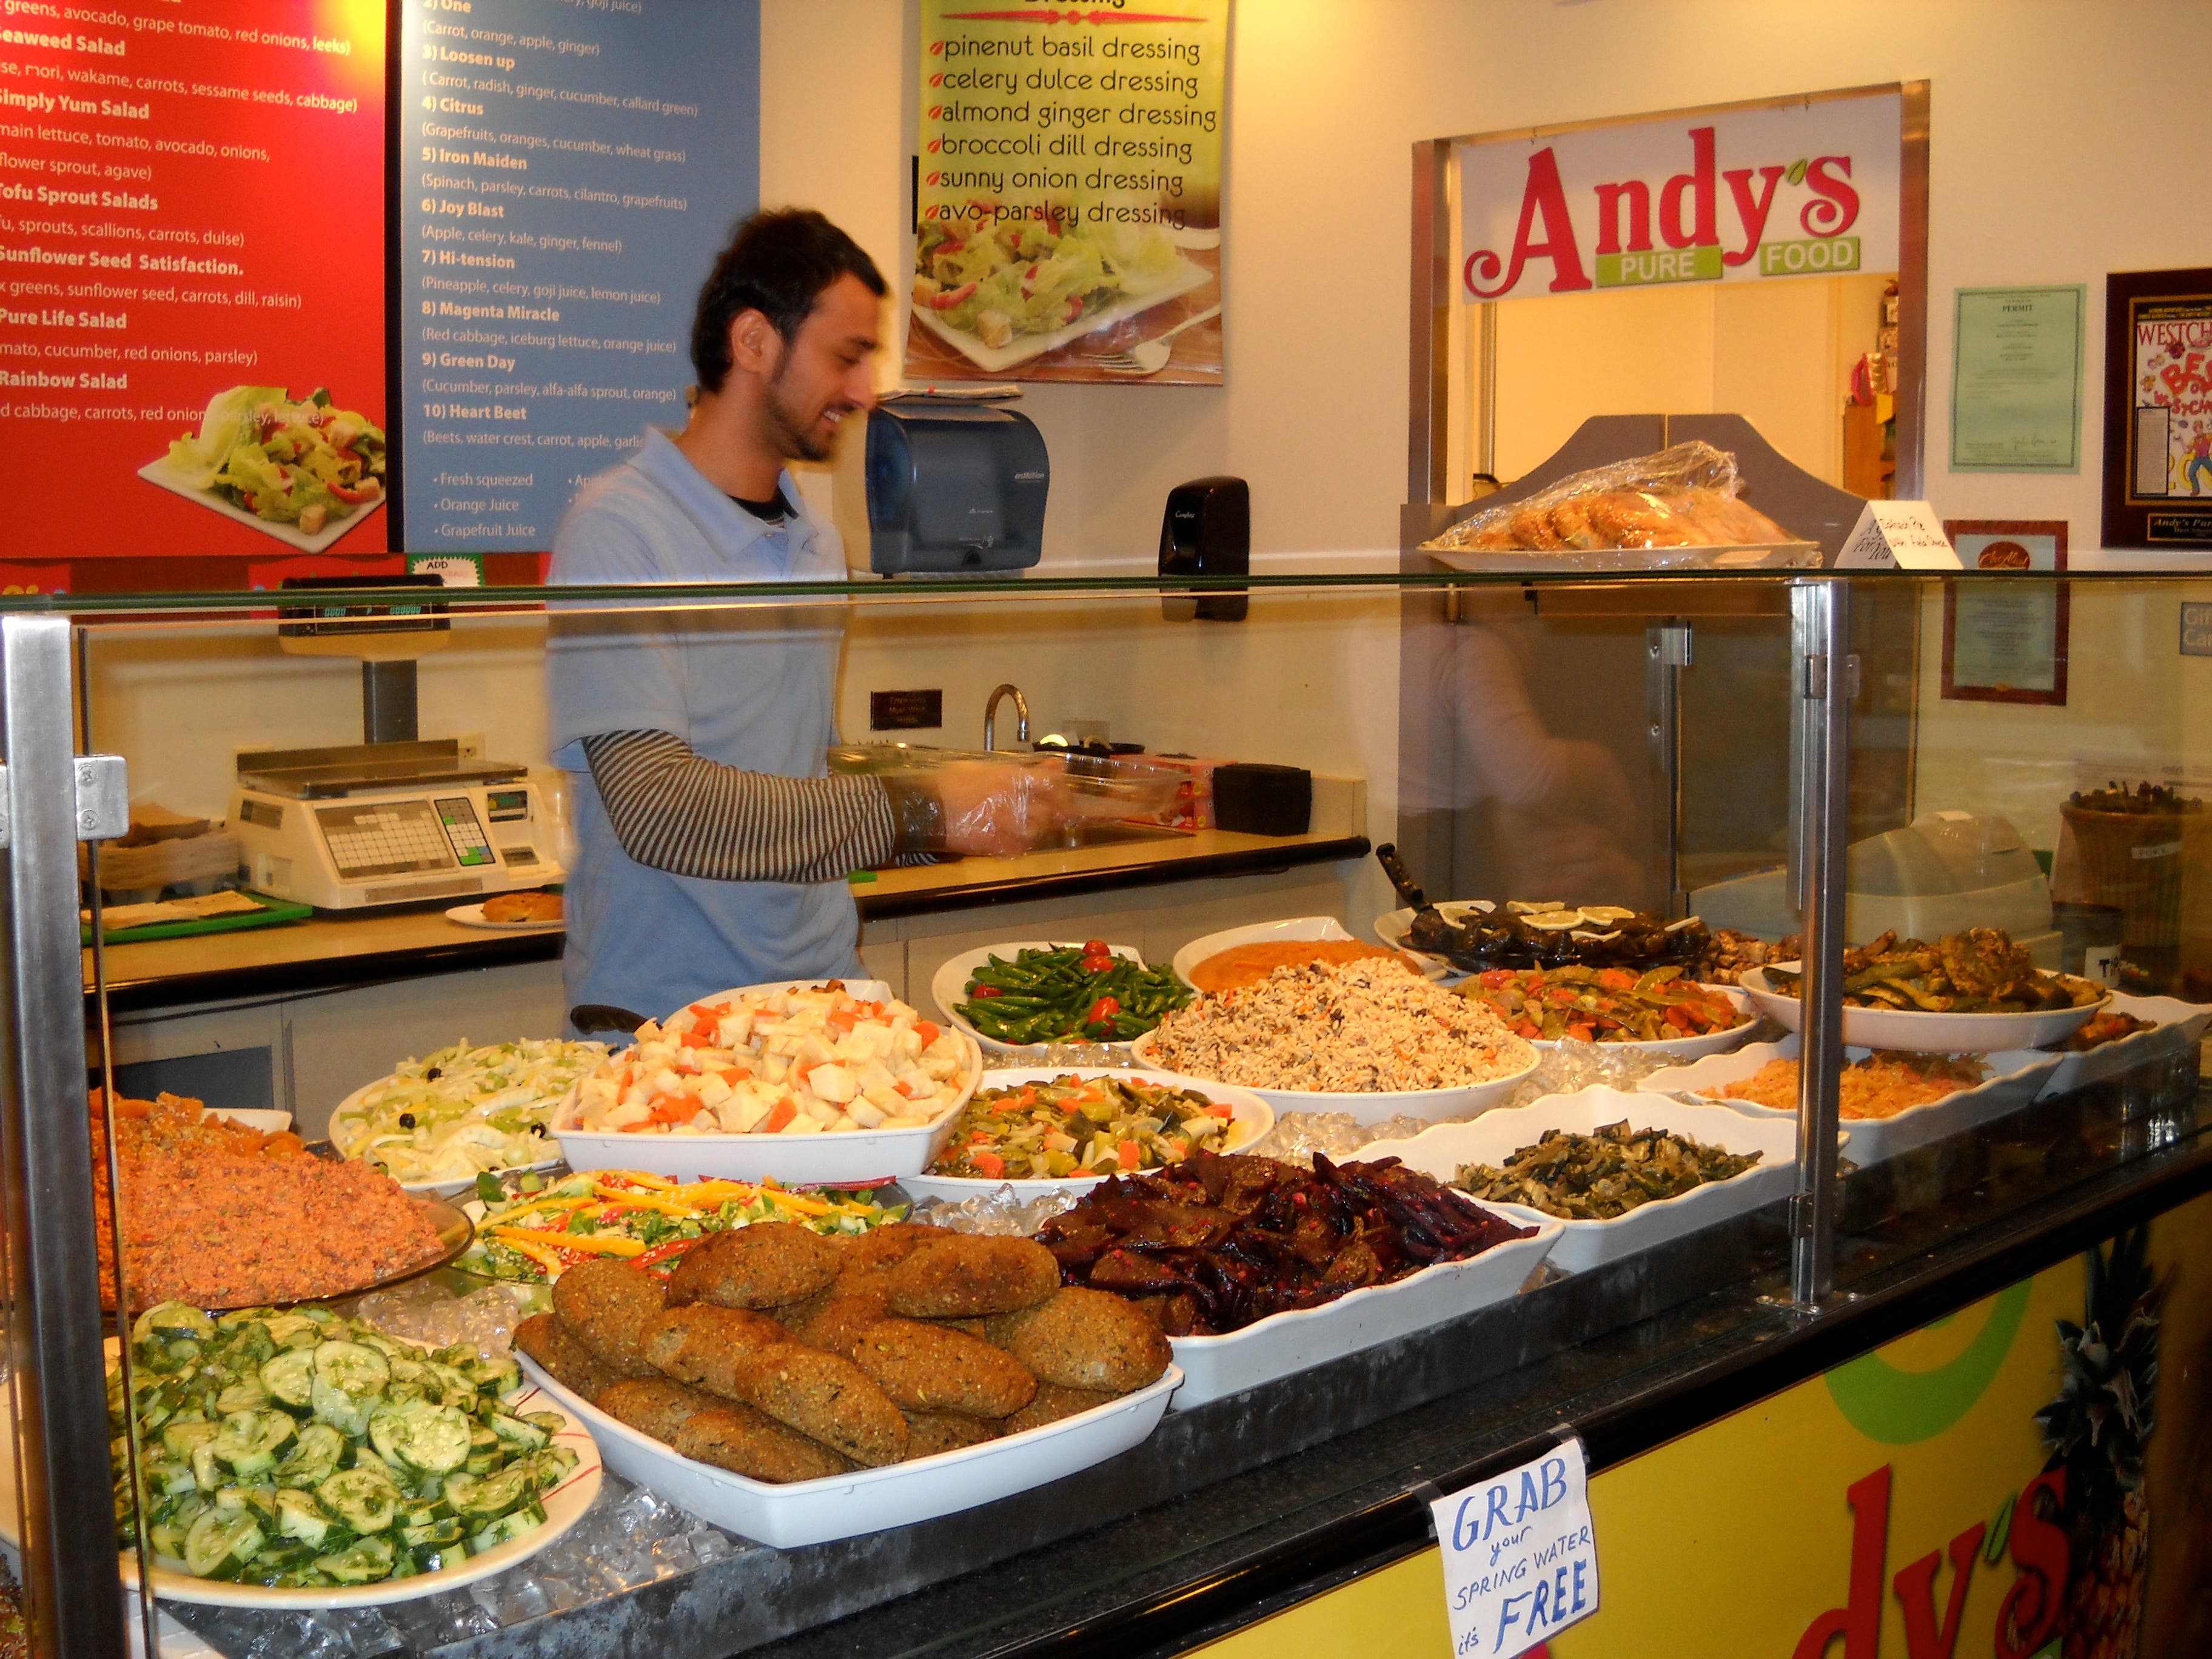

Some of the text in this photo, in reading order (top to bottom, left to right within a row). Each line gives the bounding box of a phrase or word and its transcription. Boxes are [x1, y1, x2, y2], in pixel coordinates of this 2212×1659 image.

[0, 25, 126, 56] eaweed Salad
[5, 0, 350, 56] greens, avocado, grape tomato, red onions, leeks)
[471, 29, 600, 56] orange, apple, ginger)
[945, 35, 1200, 65] pinenut basil dressing
[440, 47, 515, 72] Loosen up
[68, 69, 357, 113] wakame, carrots, sessame seeds, cabbage)
[943, 67, 1198, 99] celery dulce dressing
[59, 95, 149, 119] Yum Salad
[440, 96, 484, 115] Citrus
[474, 78, 698, 117] radish, ginger, cucumber, green)
[942, 100, 1216, 132] almond ginger dressing
[38, 124, 270, 163] lettuce, tomato, avocado, onions,
[500, 133, 686, 163] oranges, cucumber, wheat grass)
[942, 133, 1192, 164] broccoli dill dressing
[50, 160, 152, 181] sprout, agave)
[440, 148, 528, 170] Iron Maiden
[940, 167, 1183, 197] sunny onion dressing
[38, 186, 158, 210] Sprout Salads
[440, 199, 504, 218] Joy Blast
[481, 181, 687, 211] parsley, carrots, cilantro, grapefruits)
[940, 200, 1185, 230] avo-parsley dressing
[1464, 126, 1860, 298] Andy's
[19, 218, 78, 236] sprouts,
[81, 222, 145, 241] scallions,
[149, 228, 199, 245] carrots,
[203, 230, 245, 248] dulse)
[468, 229, 622, 254] celery, kale, ginger, fennel)
[0, 245, 244, 275] Sunflower Seed Satisfaction.
[440, 250, 515, 269] Hi-tension
[1620, 240, 1854, 282] PURE FOOD
[10, 281, 64, 297] greens,
[68, 283, 138, 300] sunflower
[142, 287, 178, 303] seed,
[182, 290, 231, 306] carrots,
[235, 290, 259, 307] dill,
[262, 294, 301, 310] raisin)
[493, 281, 661, 304] celery, juice, lemon juice)
[0, 308, 127, 329] Pure Life Salad
[440, 302, 560, 321] Magenta Miracle
[453, 329, 677, 354] cabbage, iceburg lettuce, orange juice)
[44, 344, 258, 367] cucumber, red onions, parsley)
[440, 353, 515, 372] Green Day
[0, 370, 127, 389] Rainbow Salad
[423, 378, 676, 403] (Cucumber, parsley, alfa-alfa sprout, orange)
[15, 403, 164, 422] cabbage, carrots, red
[450, 404, 527, 420] Heart Beet
[423, 430, 612, 449] (Beets, water crest, carrot, apple,
[440, 472, 533, 488] Fresh squeezed
[441, 498, 519, 514] Orange Juice
[441, 523, 535, 538] Grapefruit Juice
[426, 561, 448, 570] ADD
[1452, 1458, 1567, 1551] GRAB
[1490, 1526, 1533, 1567] your
[1453, 1526, 1590, 1610] SPRING WATER
[1458, 1558, 1586, 1655] it's FREE
